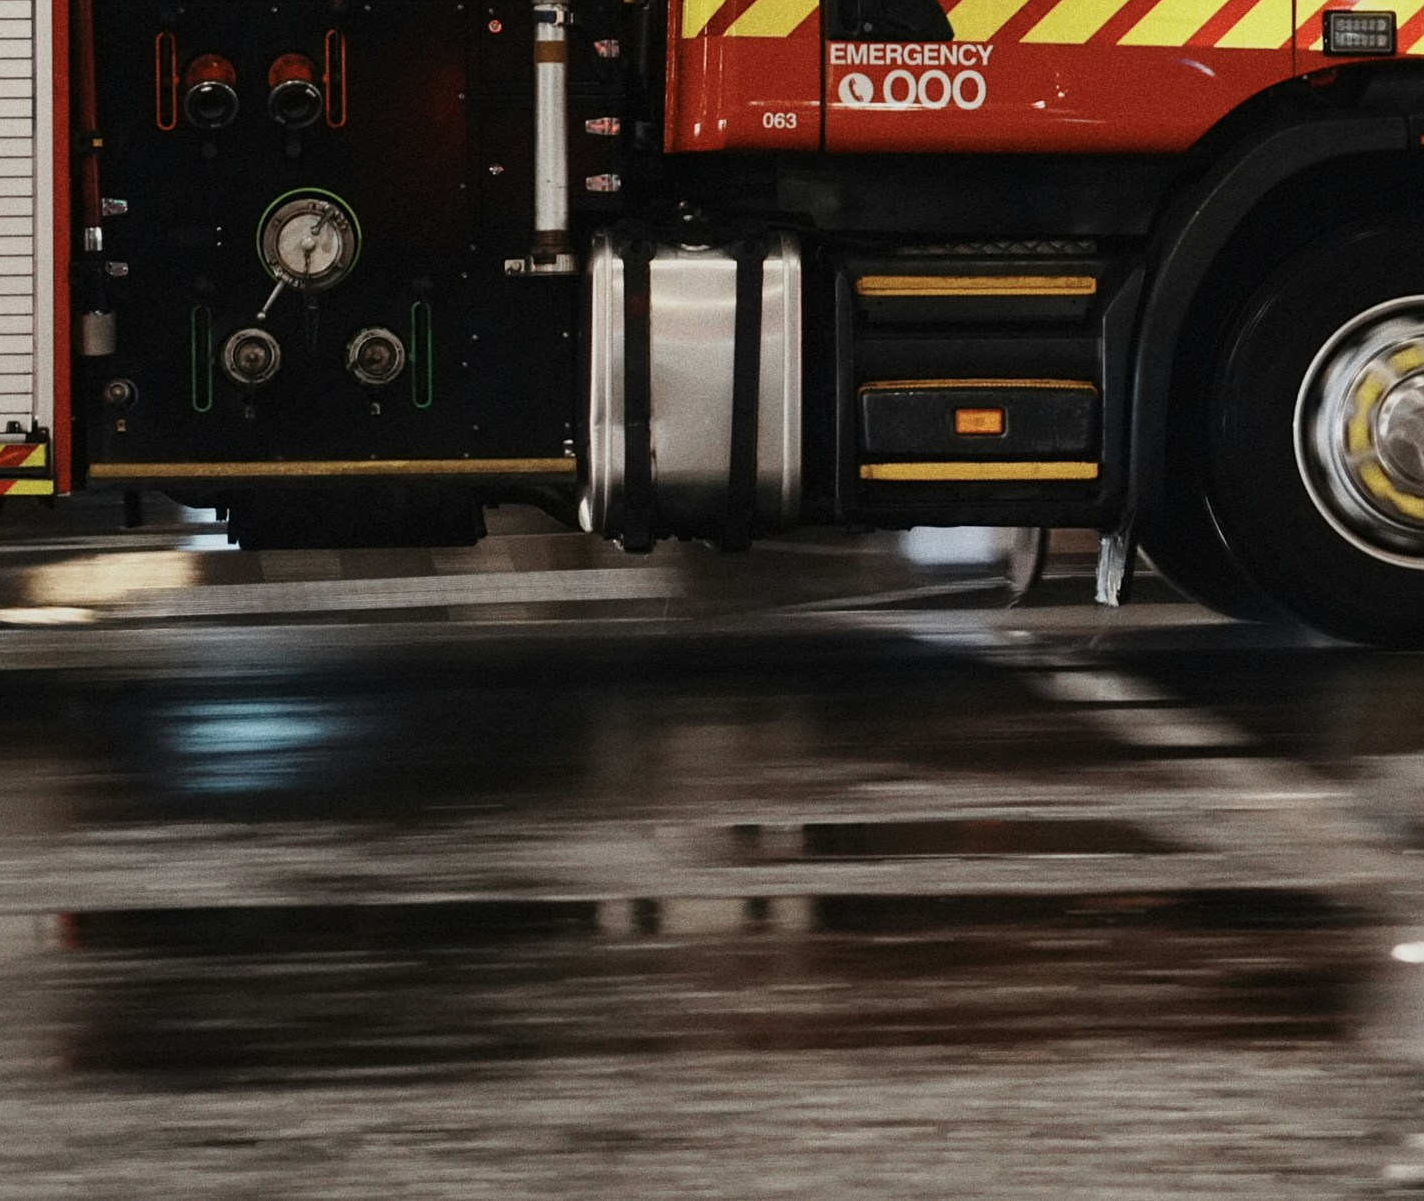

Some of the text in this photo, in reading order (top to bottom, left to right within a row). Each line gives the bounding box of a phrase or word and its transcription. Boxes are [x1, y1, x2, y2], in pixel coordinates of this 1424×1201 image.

[830, 43, 994, 66] EMERGENCY
[883, 69, 987, 110] 000
[762, 111, 798, 130] 063
